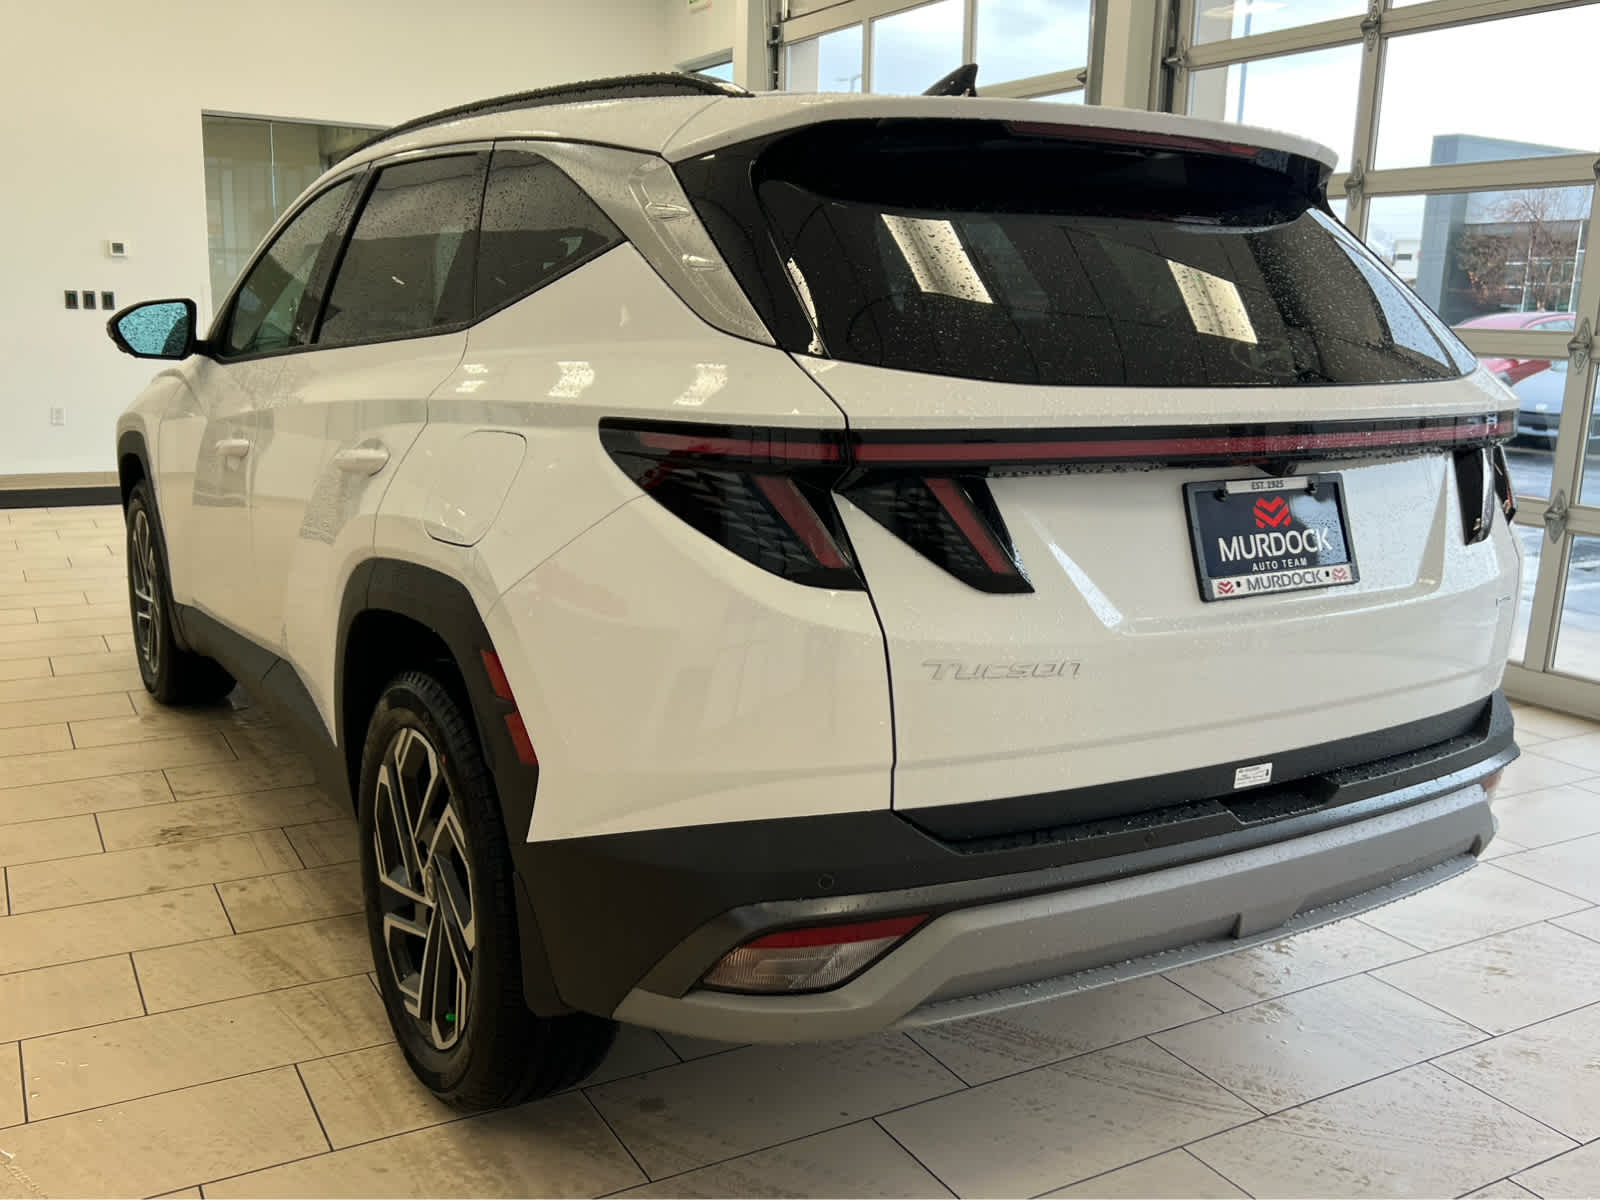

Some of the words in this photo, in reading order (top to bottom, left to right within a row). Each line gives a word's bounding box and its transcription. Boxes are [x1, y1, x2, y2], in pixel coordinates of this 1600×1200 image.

[1218, 528, 1332, 562] MURDOCK
[1252, 560, 1278, 572] AUTO
[1281, 557, 1307, 568] TEAM
[1247, 570, 1322, 591] MURDOCK
[921, 659, 1081, 680] TUCSON
